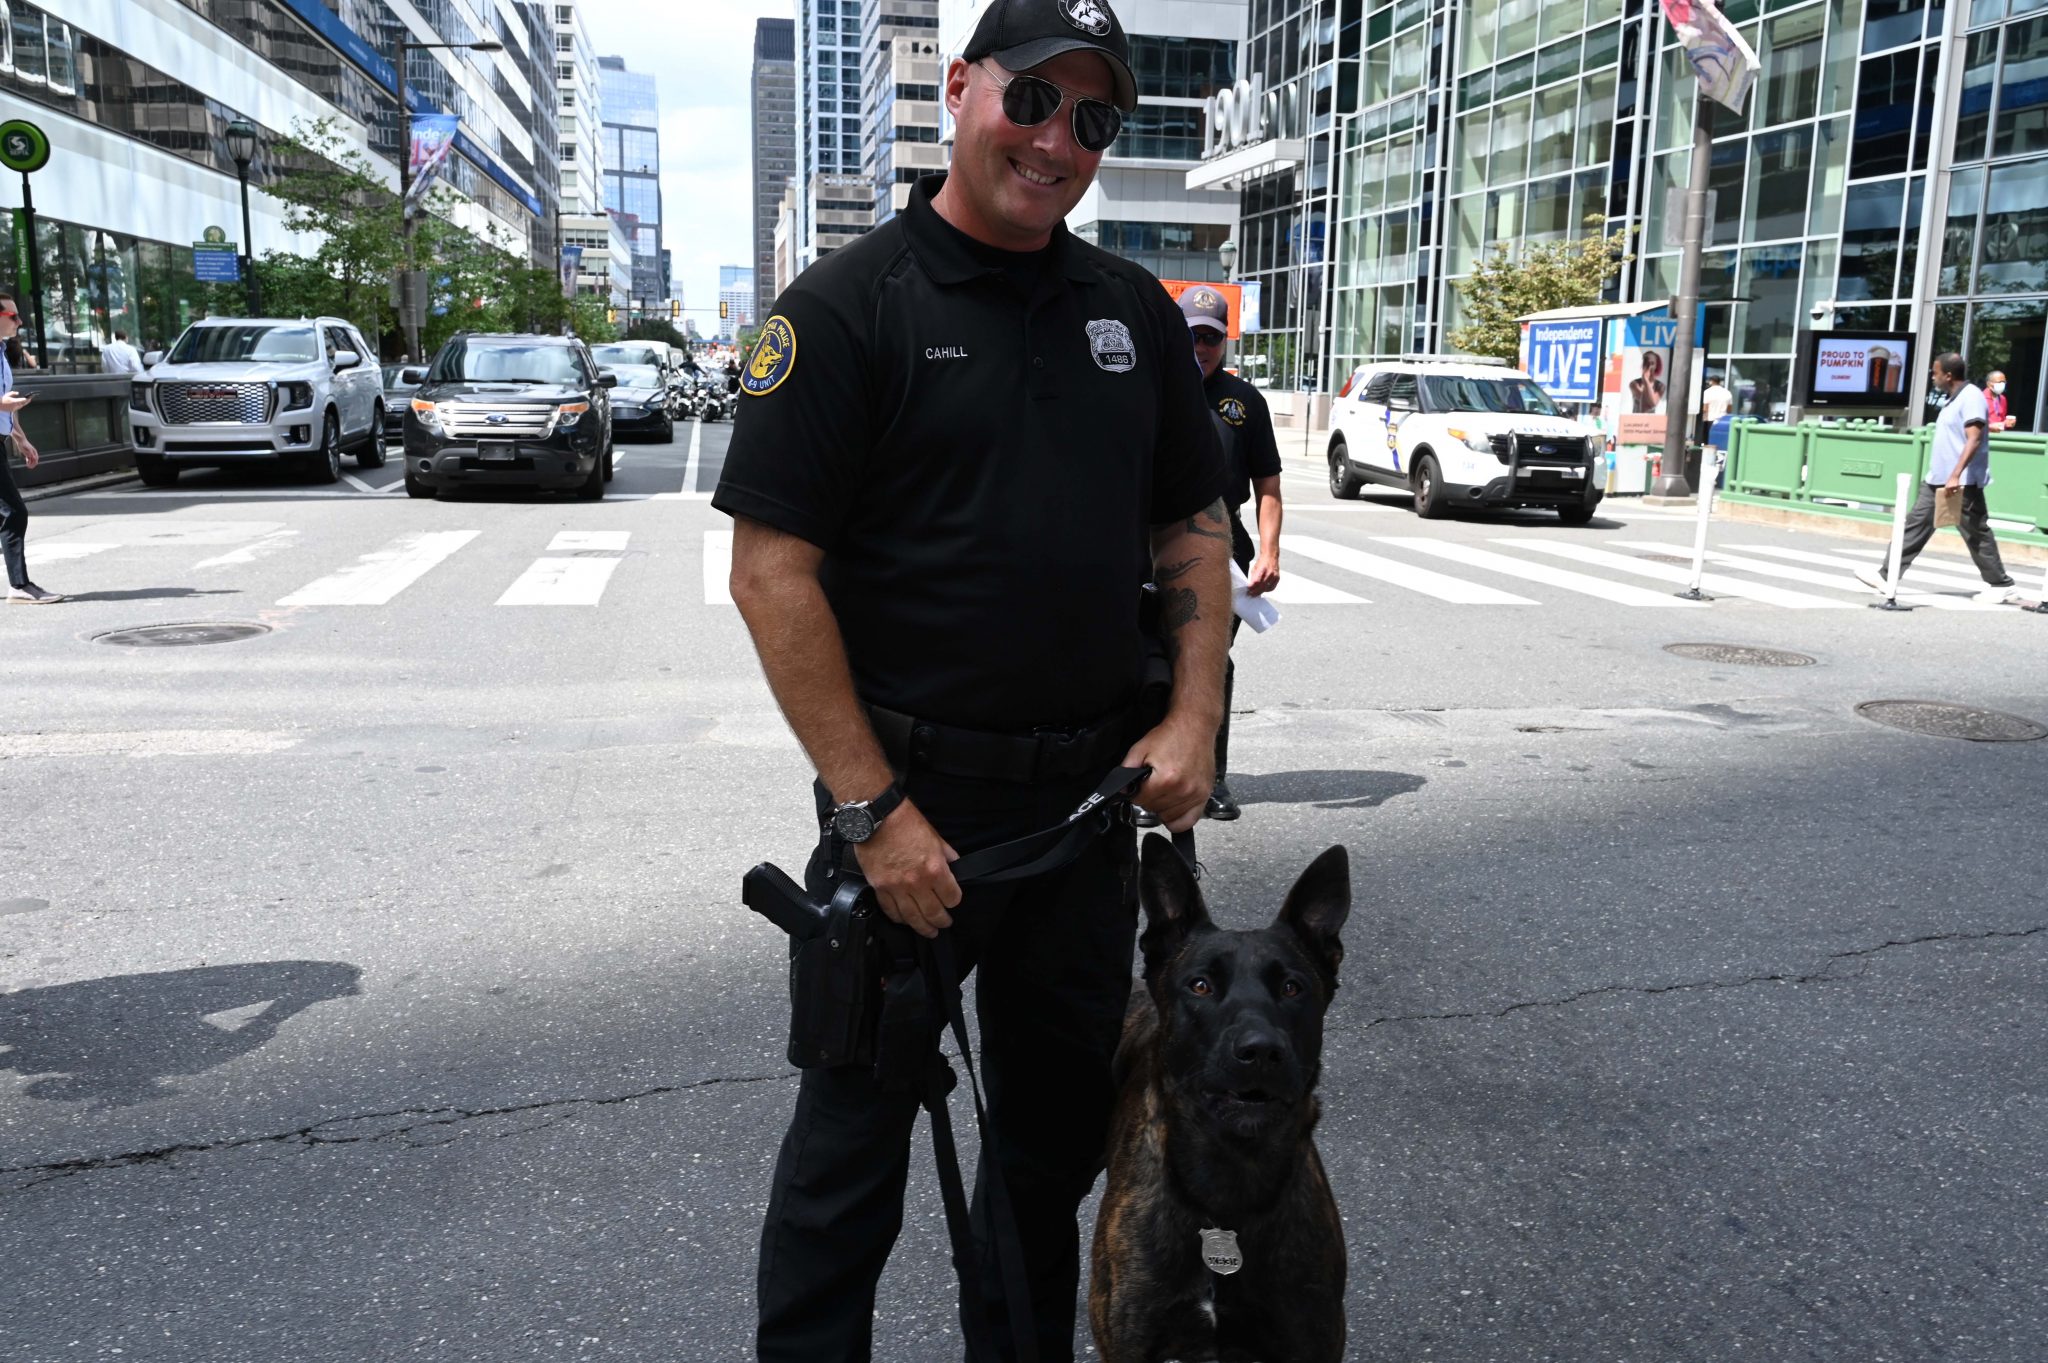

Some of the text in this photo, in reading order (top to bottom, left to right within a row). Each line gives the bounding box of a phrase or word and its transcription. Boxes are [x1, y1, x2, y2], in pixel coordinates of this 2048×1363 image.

[1201, 72, 1264, 160] 1901
[17, 228, 25, 246] Lines
[776, 324, 791, 349] POLICE
[1535, 326, 1593, 343] Independence
[1640, 325, 1678, 346] LIV
[925, 346, 968, 359] CAHILL
[1105, 354, 1129, 364] 1486
[1821, 350, 1865, 359] PROUD TO
[1533, 343, 1593, 383] LIVE
[1820, 358, 1864, 368] PUMPKIN
[747, 374, 776, 389] K-9 UNIT
